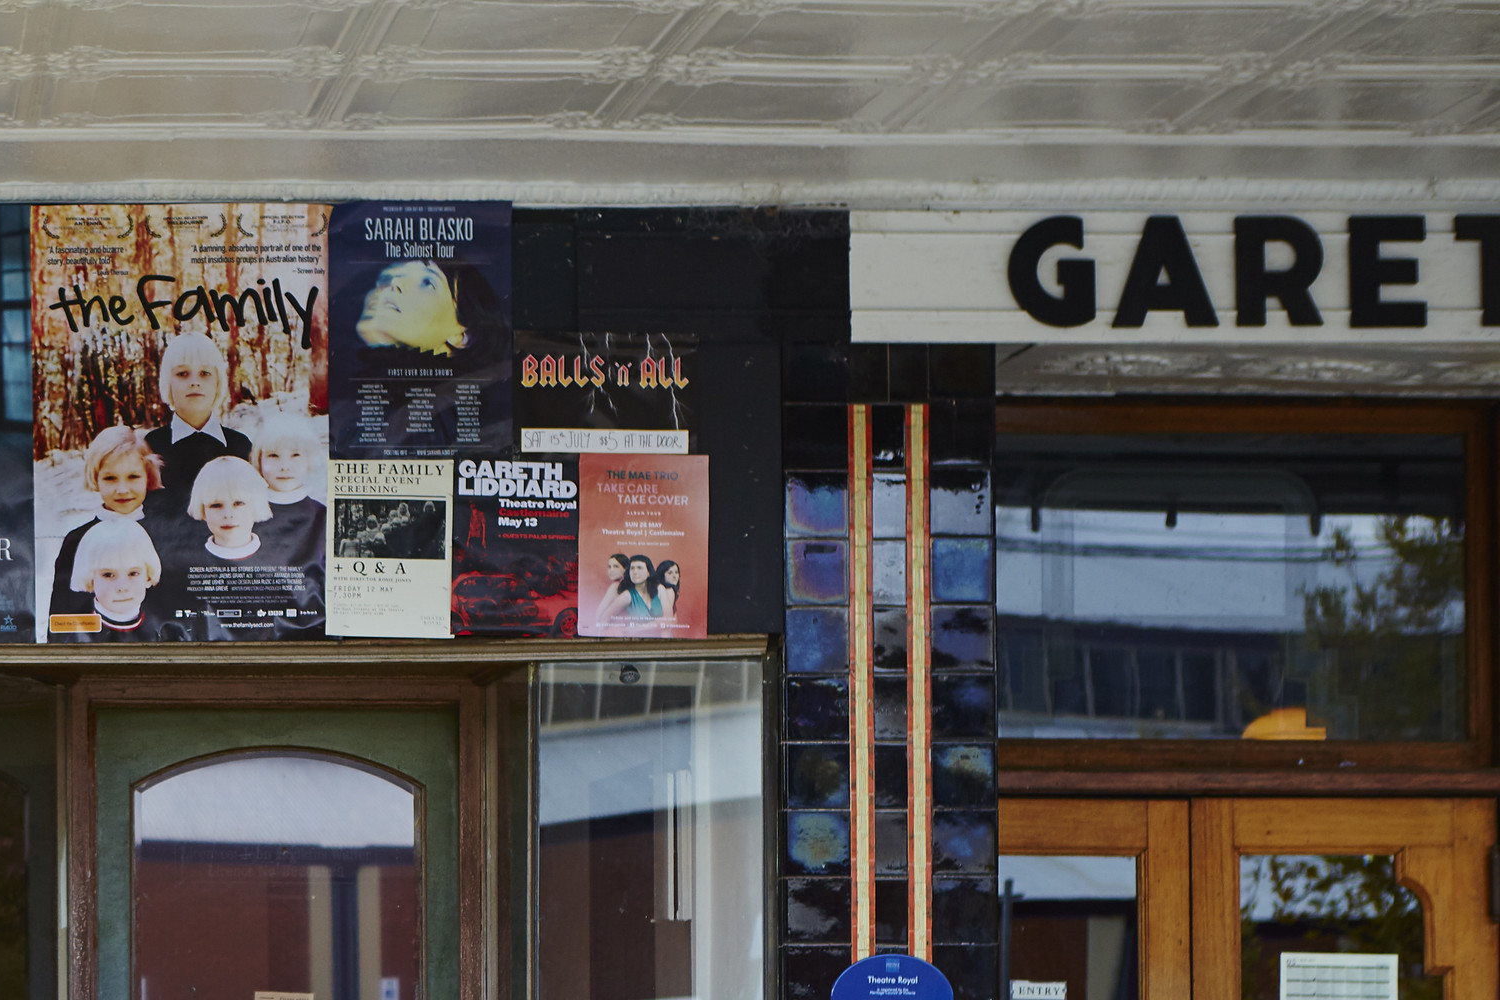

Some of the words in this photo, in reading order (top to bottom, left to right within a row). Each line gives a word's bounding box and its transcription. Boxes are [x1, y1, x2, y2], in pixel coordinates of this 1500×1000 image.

[365, 217, 414, 241] SARAH
[419, 217, 473, 241] BLASKO
[55, 247, 88, 255] fascinating
[228, 244, 258, 254] absorbing
[260, 244, 283, 254] portrait
[312, 243, 321, 251] the
[385, 242, 401, 258] The
[403, 242, 433, 258] Soloist
[436, 242, 455, 258] Tour
[66, 257, 97, 266] beautifully
[191, 256, 207, 264] most
[208, 256, 234, 264] insidious
[236, 257, 257, 265] groups
[266, 255, 296, 263] Australian
[50, 284, 134, 332] the
[136, 274, 319, 349] Family
[521, 354, 605, 388] BALLS
[639, 356, 690, 390] ALL
[524, 431, 546, 449] SAT
[565, 431, 591, 449] JULY
[624, 433, 638, 448] AT
[639, 433, 652, 448] THE
[335, 463, 369, 475] THE
[378, 464, 445, 476] FAMILY
[458, 459, 562, 480] GARETH
[607, 470, 626, 479] THE
[628, 471, 651, 480] MAE
[653, 471, 678, 480] TRIO
[334, 476, 380, 484] SPECIAL
[386, 476, 422, 485] EVENT
[334, 485, 398, 493] SCREENING
[458, 477, 577, 499] LIDDIARD
[597, 483, 625, 493] TAKE
[627, 483, 658, 494] CARE
[499, 499, 543, 509] Theatre
[546, 500, 577, 511] Royal
[617, 494, 646, 505] TAKE
[648, 495, 689, 506] COVER
[499, 507, 570, 518] Castlemaine
[498, 517, 522, 528] May
[524, 517, 538, 527] 13
[334, 563, 343, 573] +
[353, 561, 367, 576] Q
[375, 562, 386, 574] &
[395, 562, 407, 574] A
[868, 976, 896, 984] Theatre
[898, 976, 918, 985] Royal
[1019, 986, 1060, 995] ENTRY
